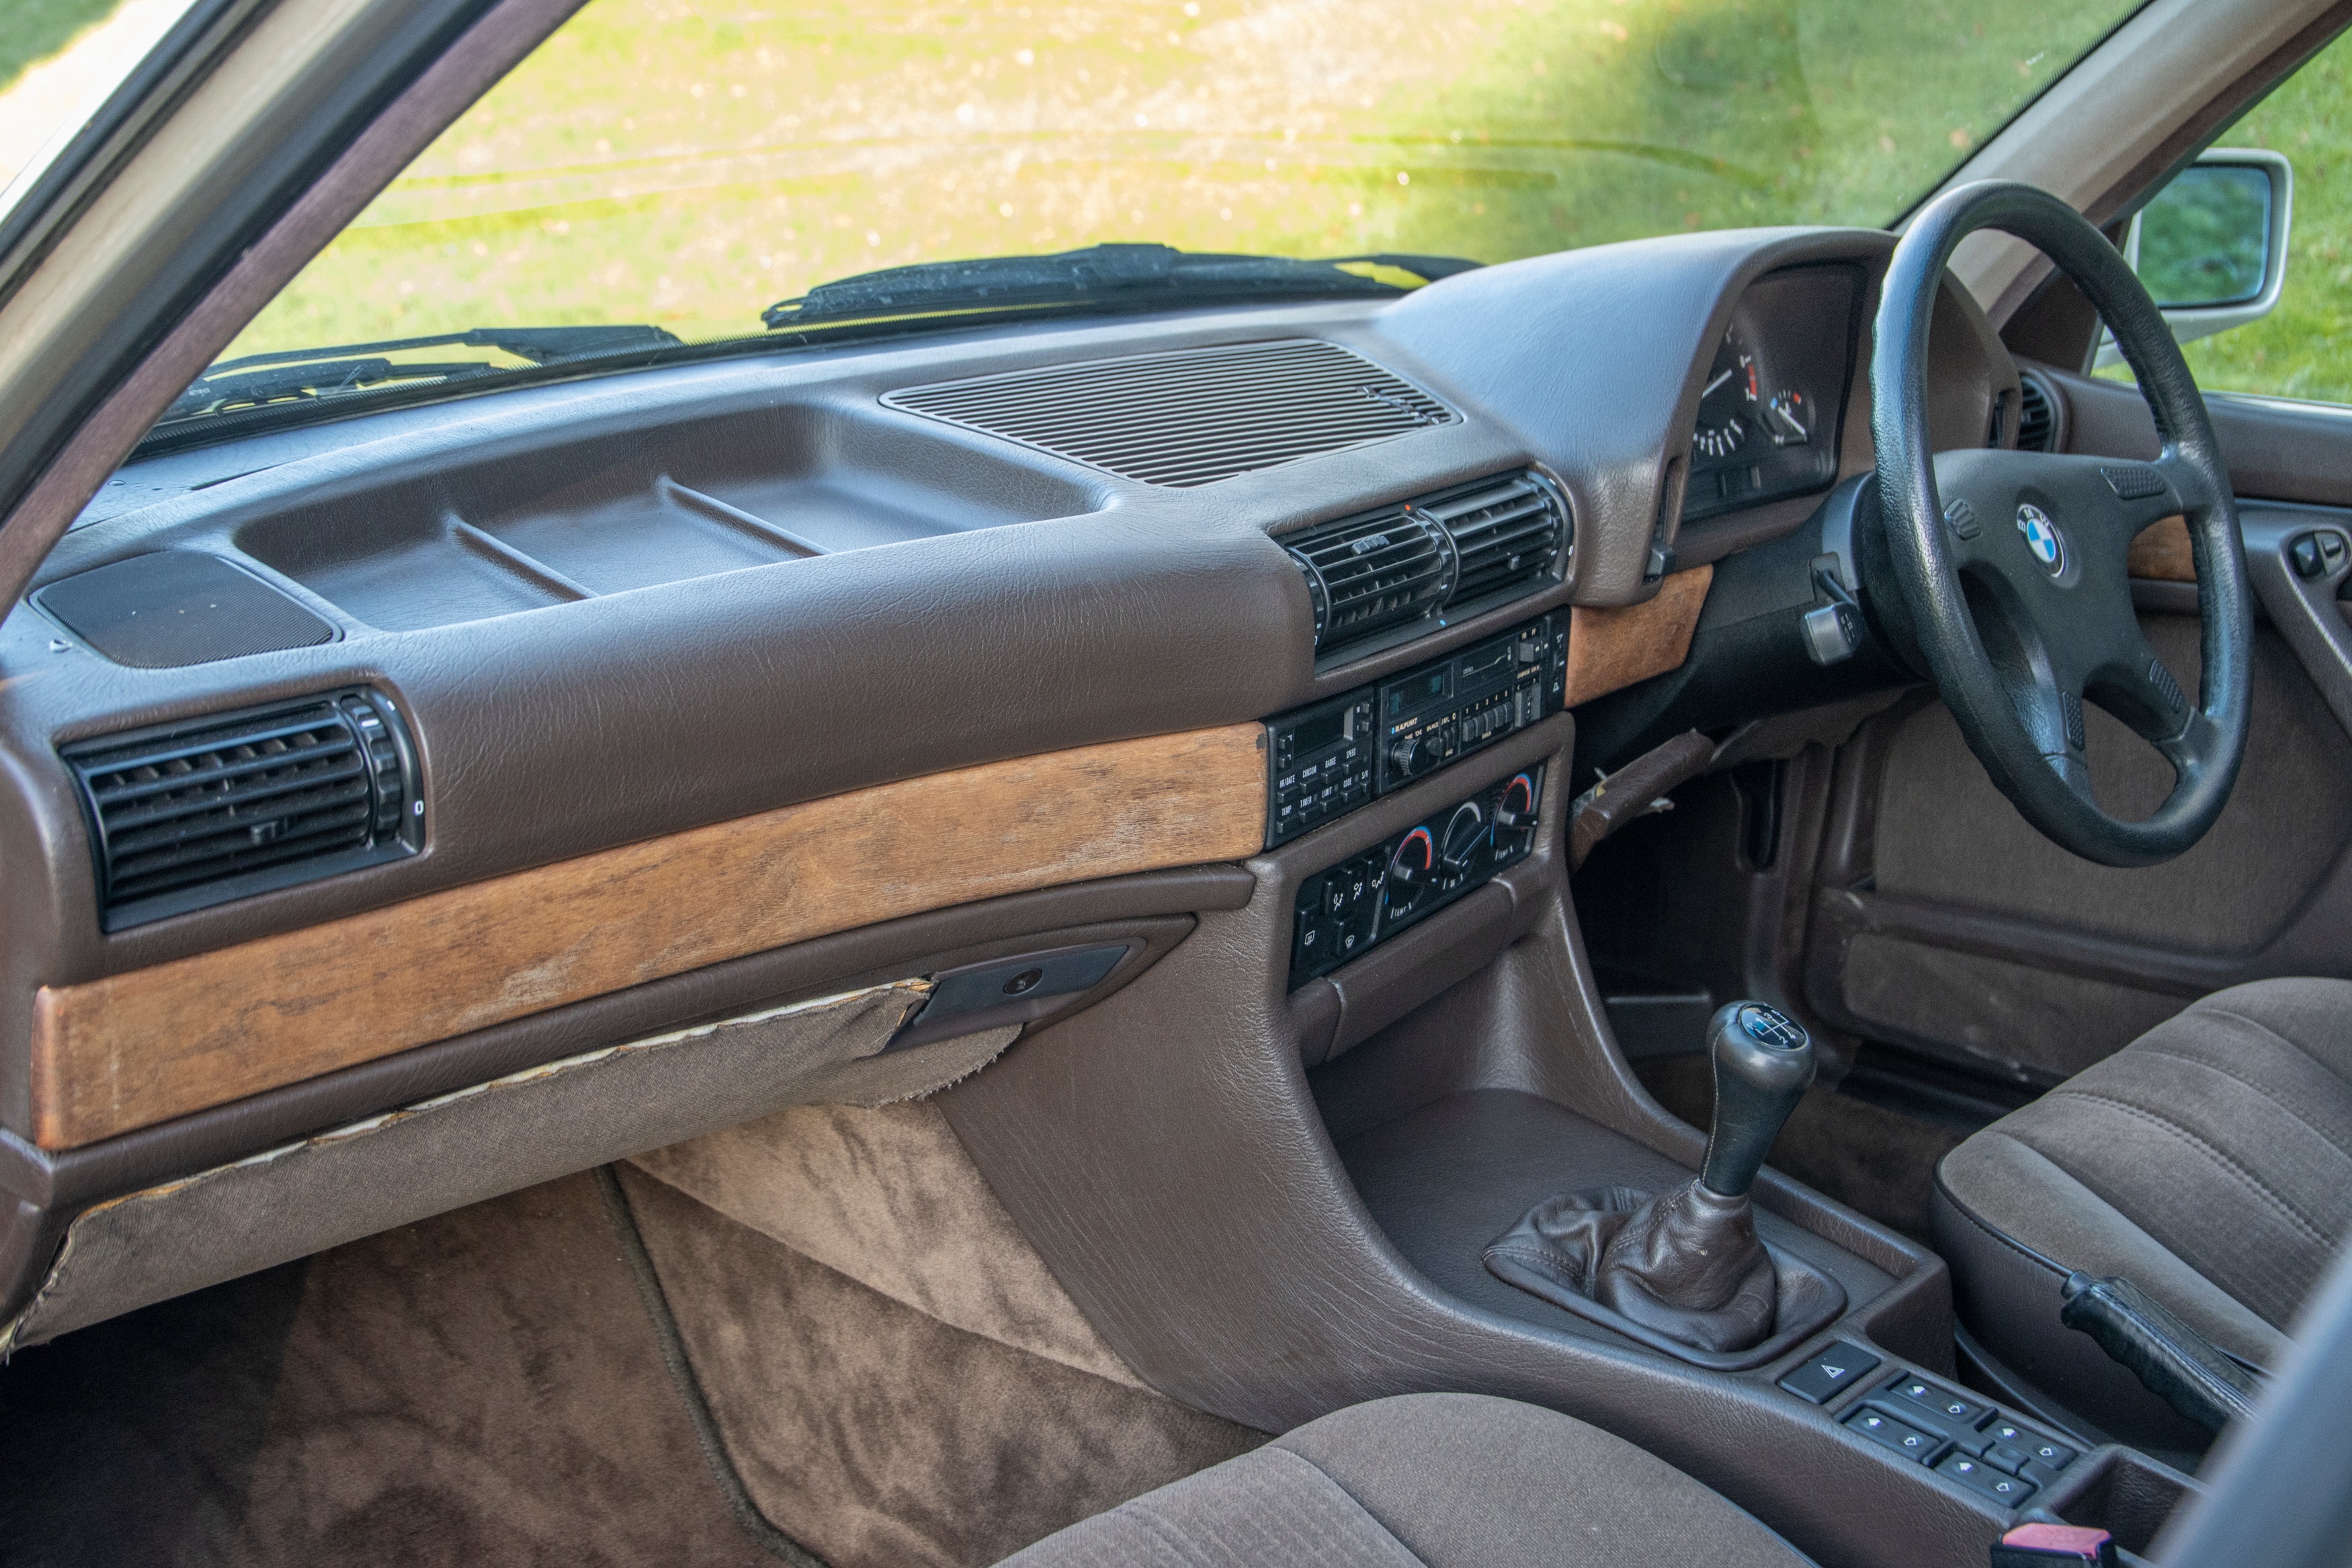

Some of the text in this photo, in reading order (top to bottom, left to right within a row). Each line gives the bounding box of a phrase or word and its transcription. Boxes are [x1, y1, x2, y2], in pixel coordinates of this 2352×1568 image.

[2017, 507, 2049, 533] BMW
[1395, 717, 1418, 733] BLAUPUNKT
[1279, 748, 1356, 789] HR/DATE CONSUM RANGE SPEED
[1282, 805, 1292, 816] TEMP
[1300, 795, 1312, 808] TIMER
[1322, 786, 1333, 798] LIMIT
[1343, 777, 1352, 788] CODE
[1778, 1035, 1788, 1045] 2
